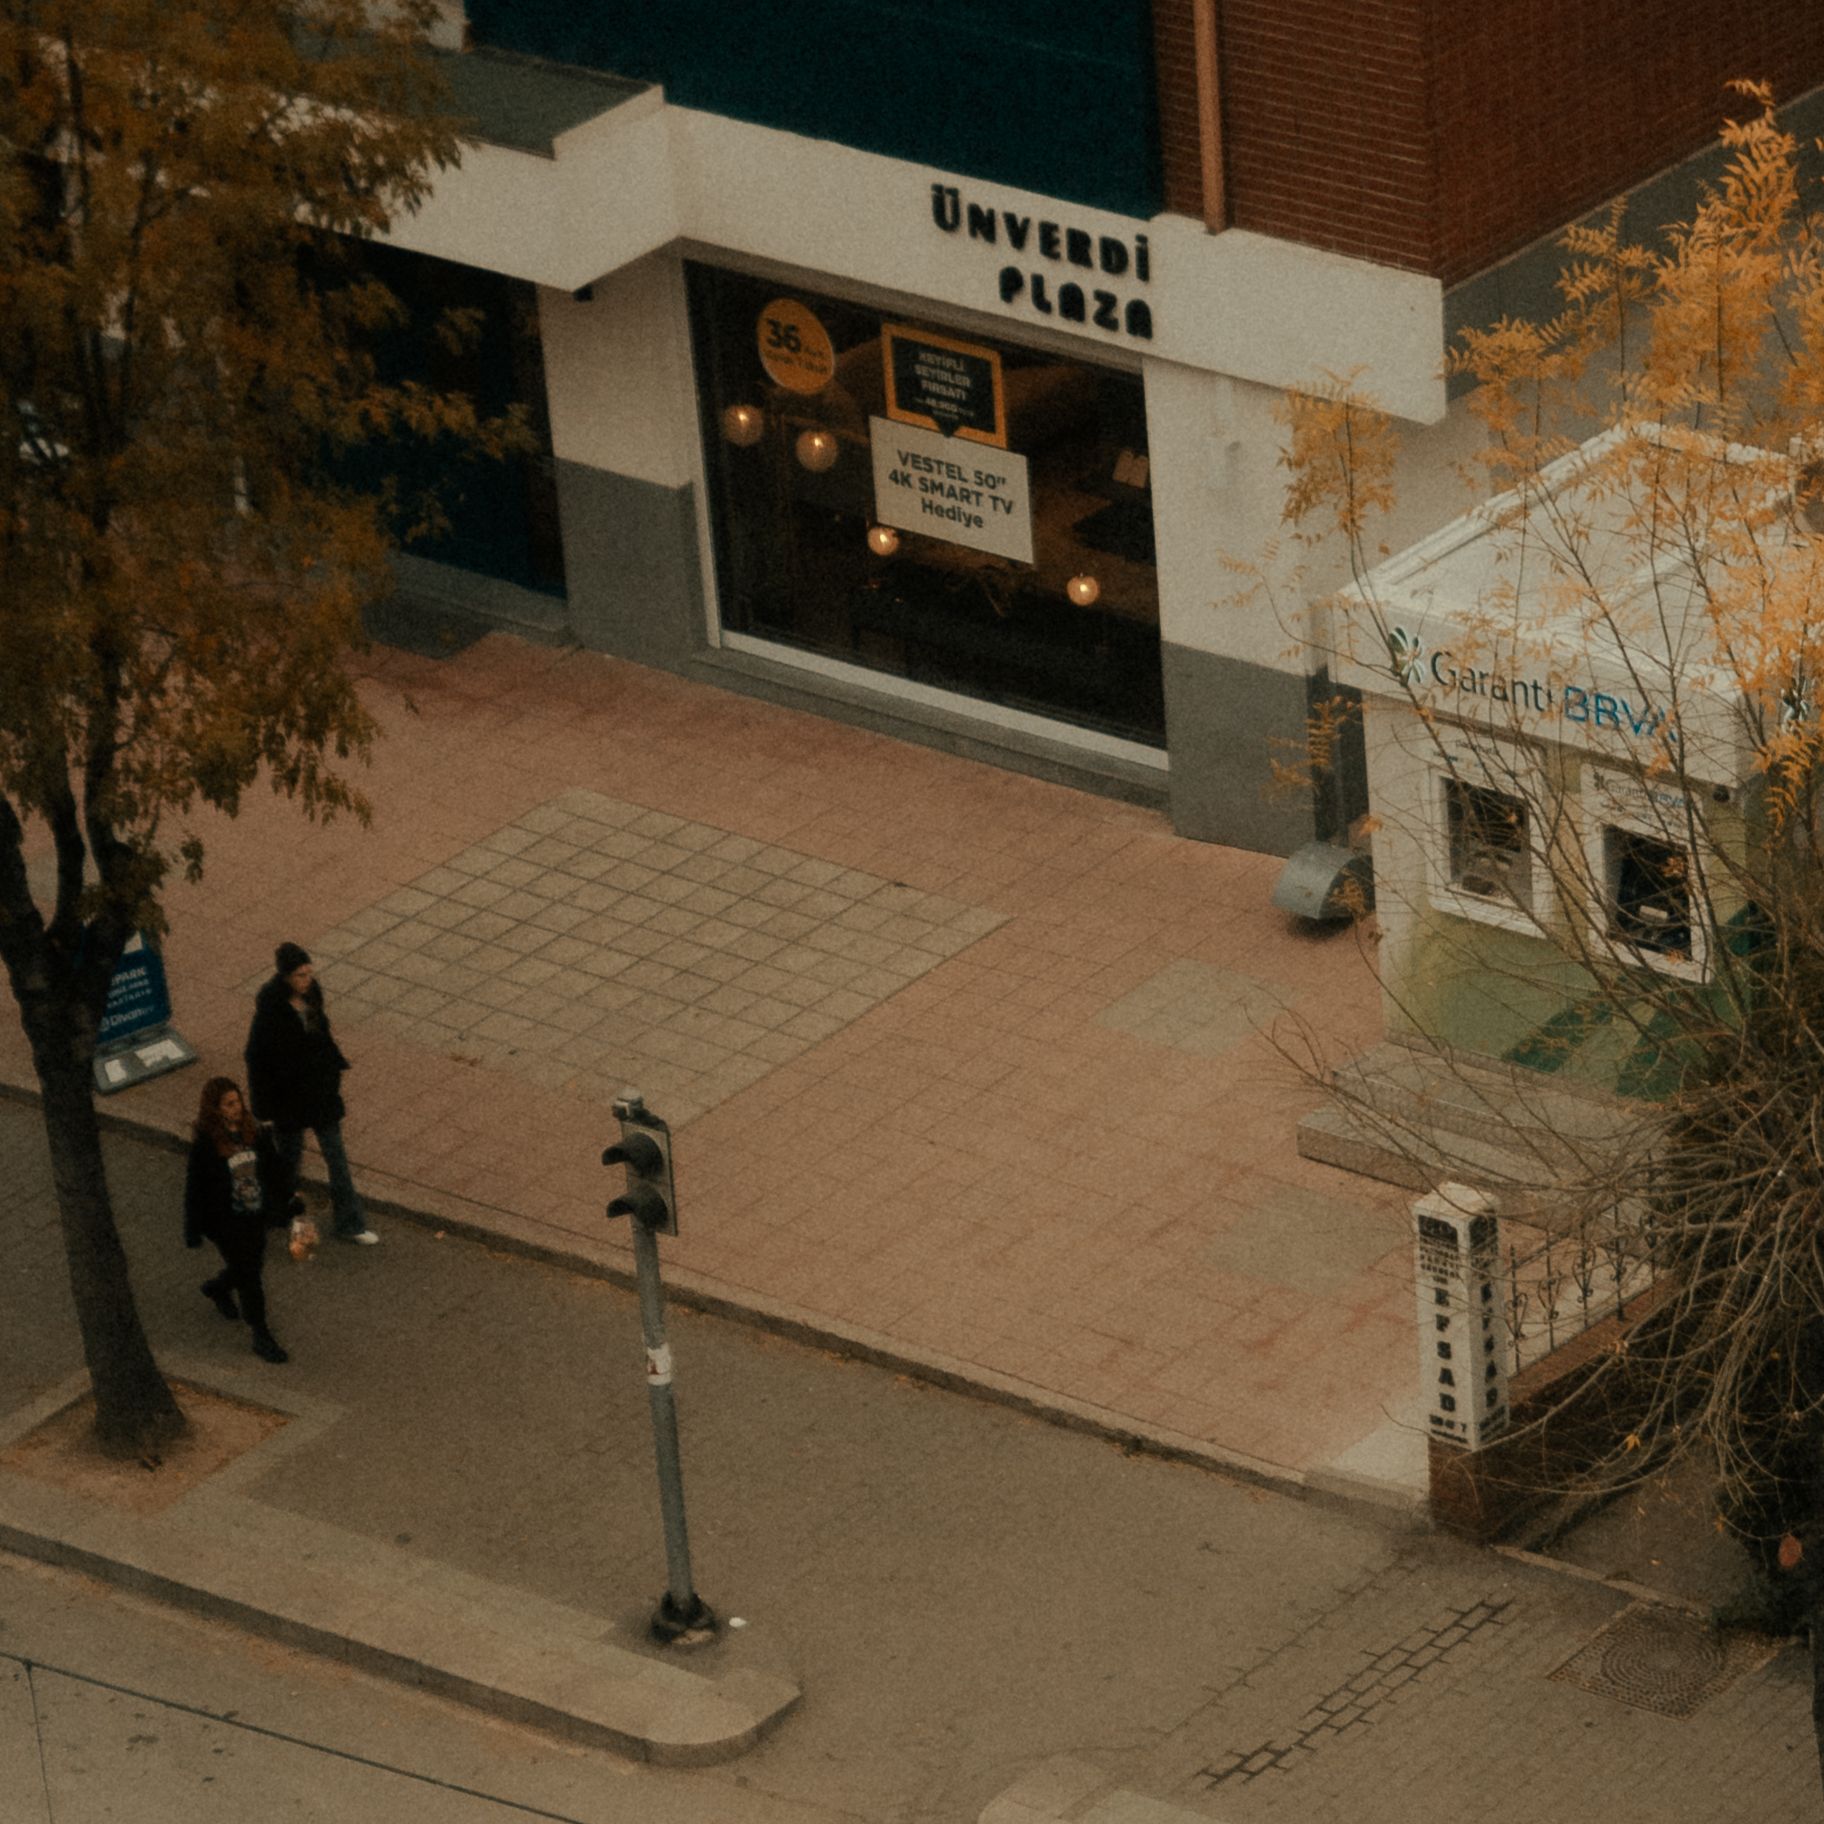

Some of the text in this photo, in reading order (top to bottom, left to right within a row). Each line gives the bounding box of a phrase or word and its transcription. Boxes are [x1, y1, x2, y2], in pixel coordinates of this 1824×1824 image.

[931, 184, 1149, 283] ÜNVERDİ
[999, 266, 1153, 340] PLAZA
[765, 318, 801, 353] 36
[897, 449, 968, 484] VESTEL
[888, 469, 1013, 515] 4K SMART TV
[921, 498, 984, 528] Hediye
